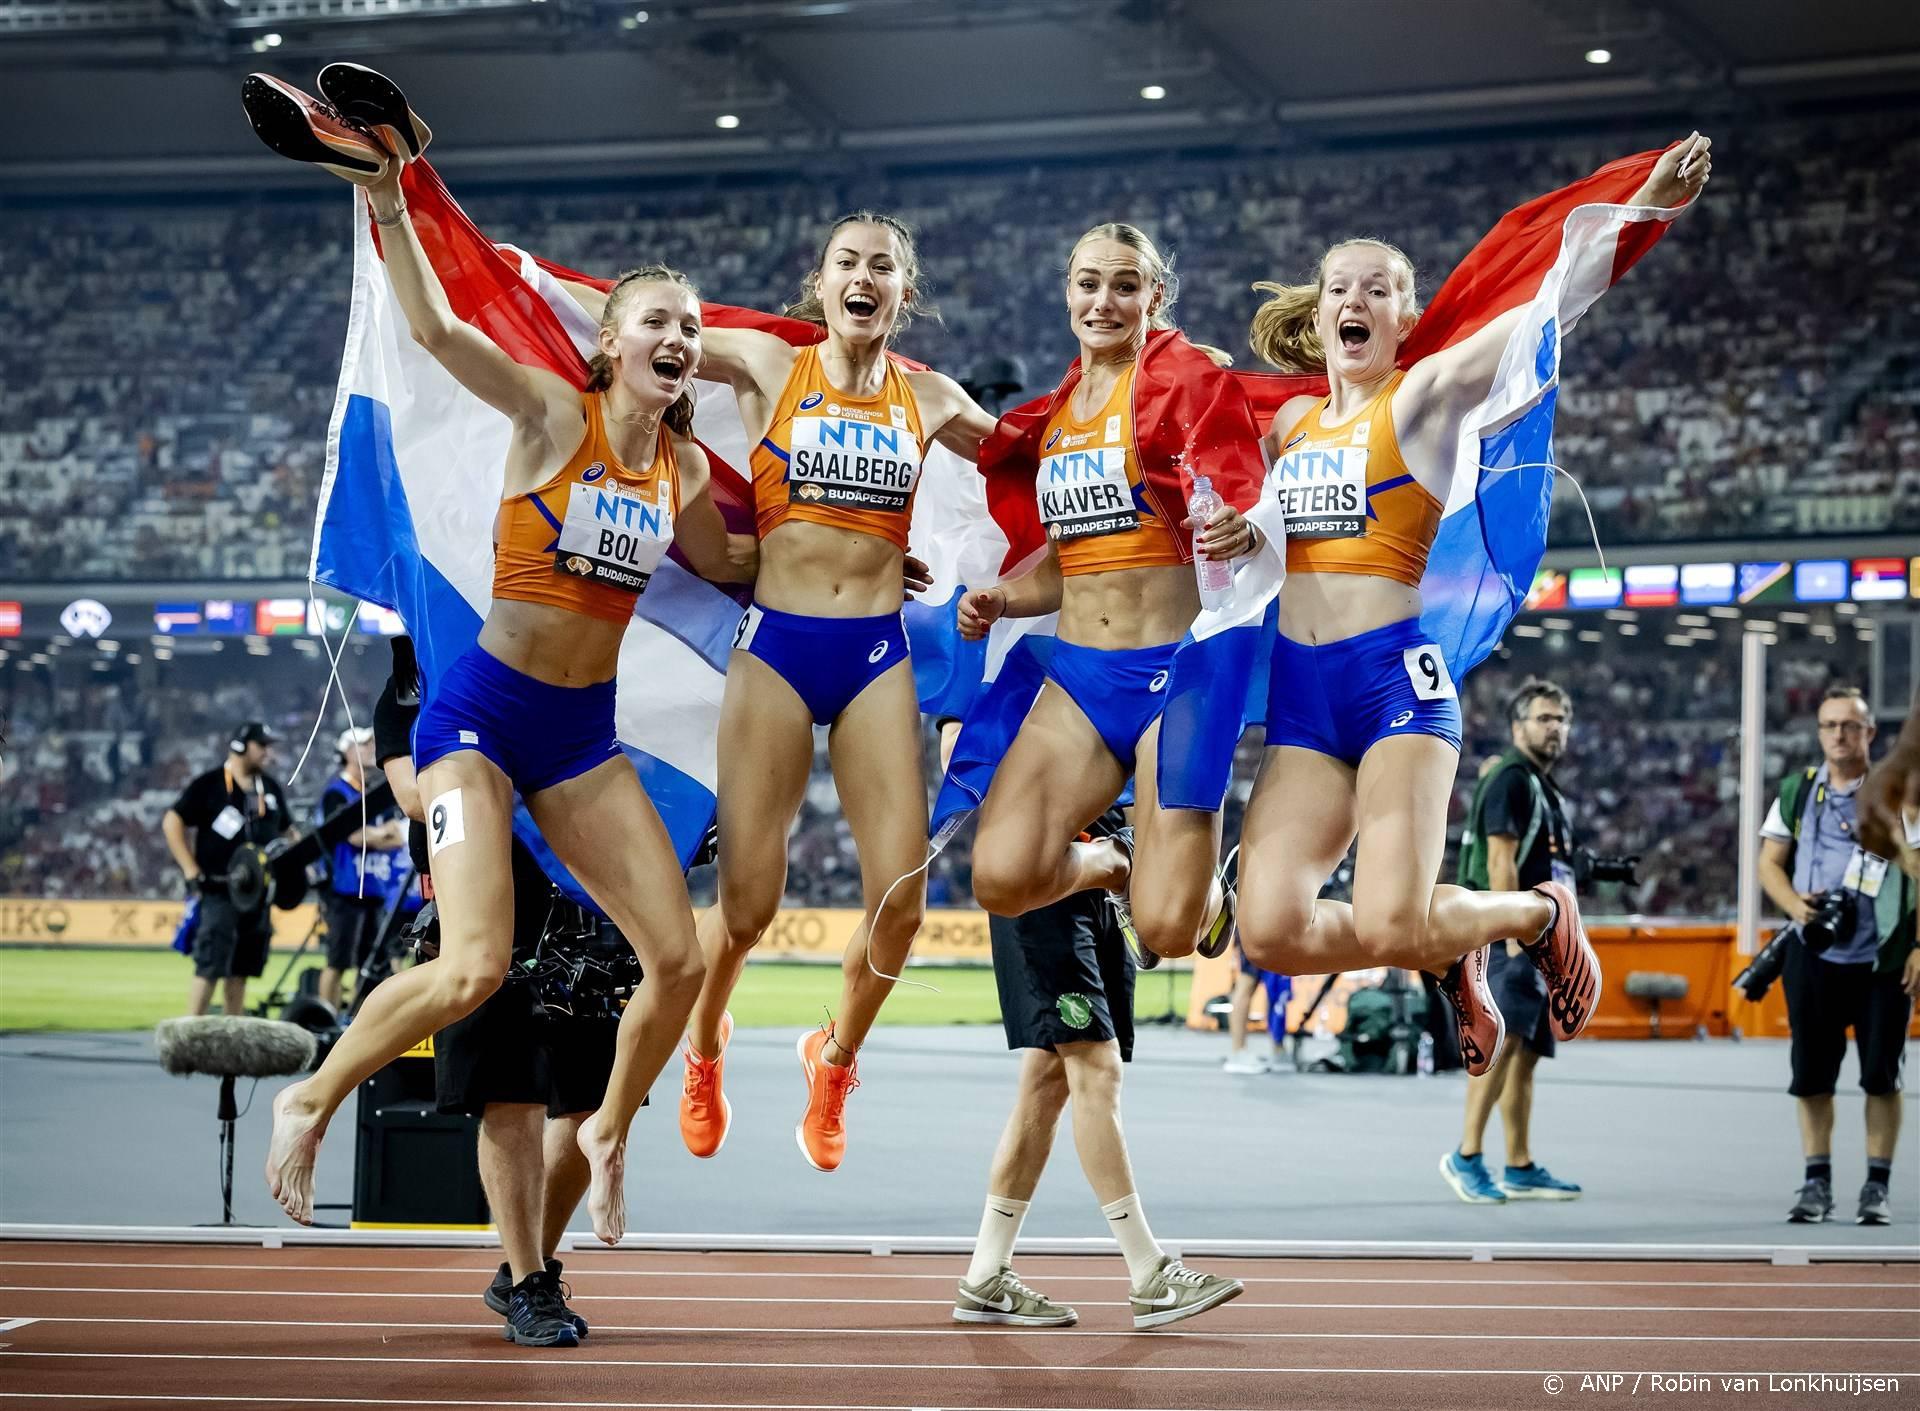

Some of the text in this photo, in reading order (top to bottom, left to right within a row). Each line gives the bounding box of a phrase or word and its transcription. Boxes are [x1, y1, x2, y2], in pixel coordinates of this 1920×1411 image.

[819, 420, 898, 455] NTN
[796, 450, 913, 488] SAALBERG
[1050, 450, 1105, 484] NTN
[1280, 449, 1344, 481] NTN
[595, 490, 661, 537] NTN
[828, 489, 905, 506] BUDAPEST 23
[1042, 483, 1124, 518] KLAVER
[1278, 484, 1357, 514] EETERS
[1063, 517, 1133, 535] BUDAPEST 23
[1286, 521, 1359, 533] BUDAPEST 23
[597, 528, 640, 566] BOL
[596, 566, 642, 588] BUDAPEST
[1418, 652, 1440, 690] 9
[432, 804, 448, 844] 9
